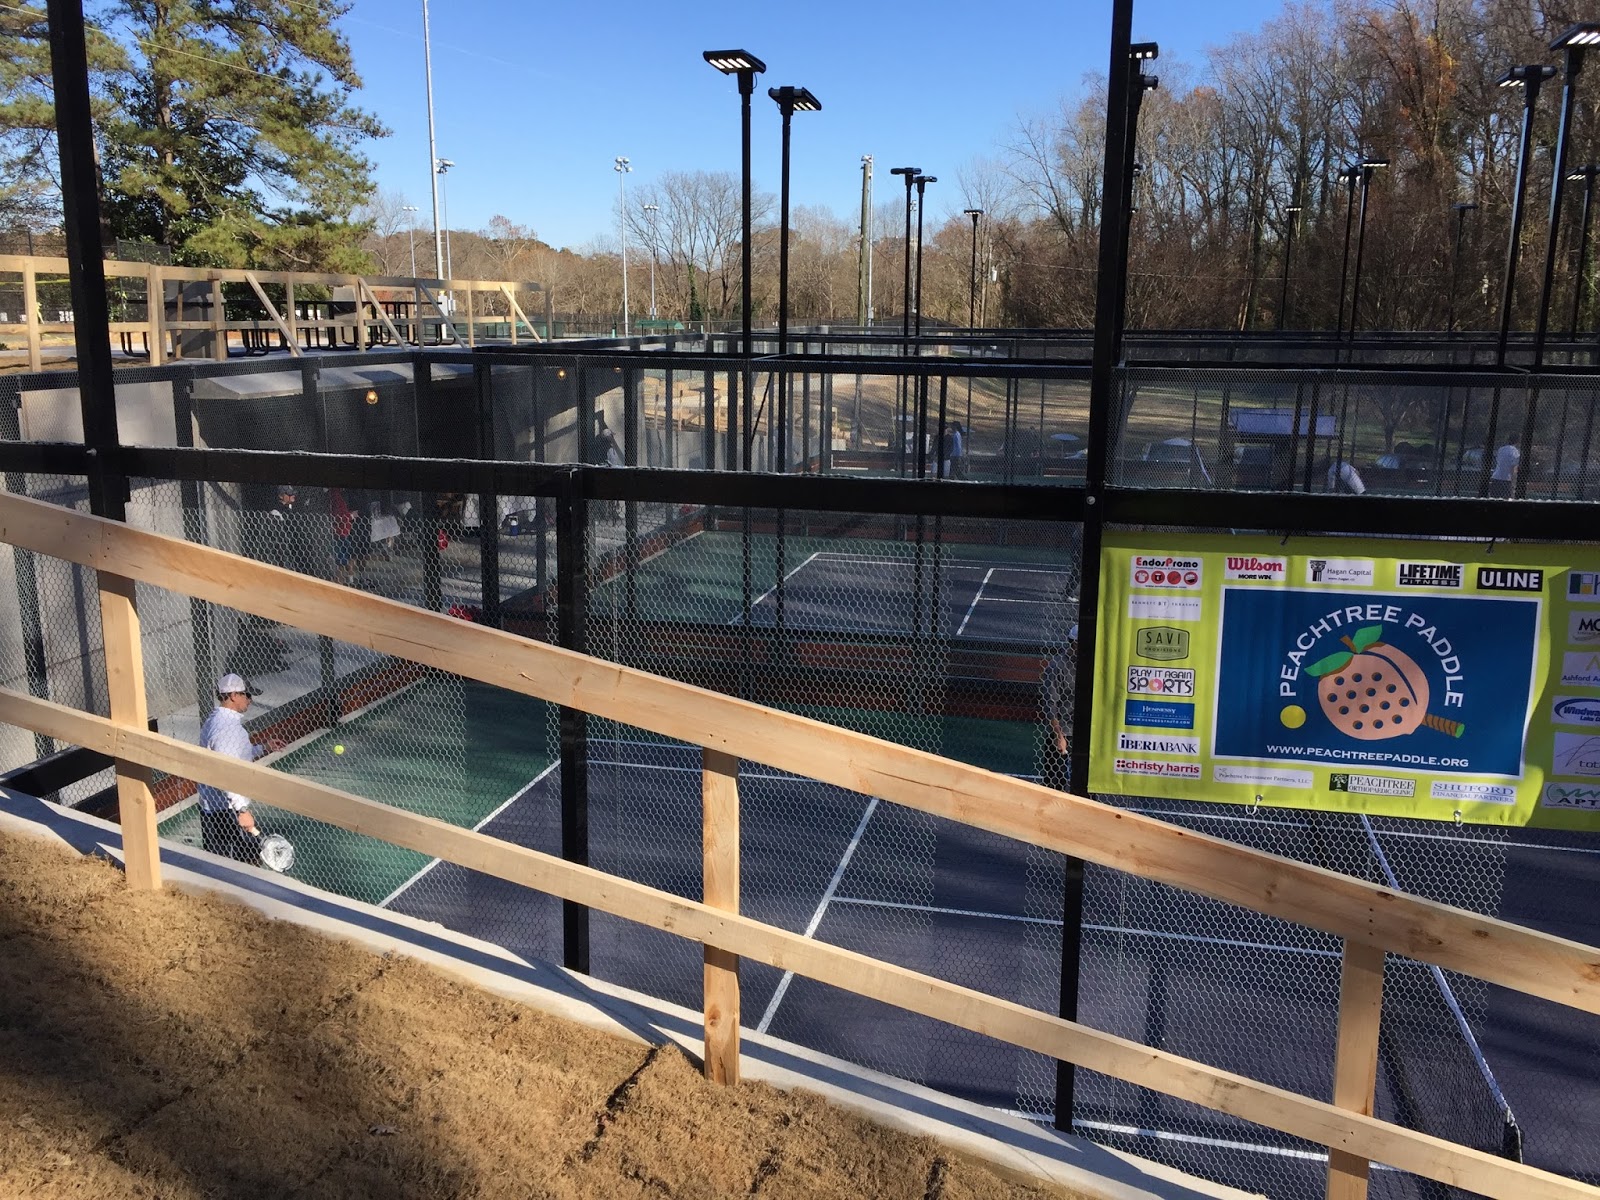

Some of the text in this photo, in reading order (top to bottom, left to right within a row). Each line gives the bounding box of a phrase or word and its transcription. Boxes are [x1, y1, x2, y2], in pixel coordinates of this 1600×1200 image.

[1135, 556, 1199, 568] EndosPromo
[1227, 557, 1283, 571] Wilson
[1327, 568, 1372, 577] Hagan Capital
[1400, 563, 1461, 579] LIFETIME
[1481, 570, 1540, 589] ULINE
[1145, 631, 1181, 645] SAVI
[1280, 604, 1464, 708] PEACHTREE PADDLE
[1130, 668, 1152, 677] PLAY
[1164, 671, 1192, 679] AGAIN
[1129, 677, 1193, 694] SPORTS
[1266, 745, 1469, 767] WWW.PEACHTREEPADDLE.ORG
[1125, 761, 1164, 773] christy
[1166, 763, 1200, 774] harris
[1349, 775, 1415, 790] PEACHTREE
[1433, 783, 1514, 795] SHUFORD
[1348, 785, 1392, 795] ORTHOPAEDIC
[1432, 791, 1514, 803] FINANCIAL PARTNERS
